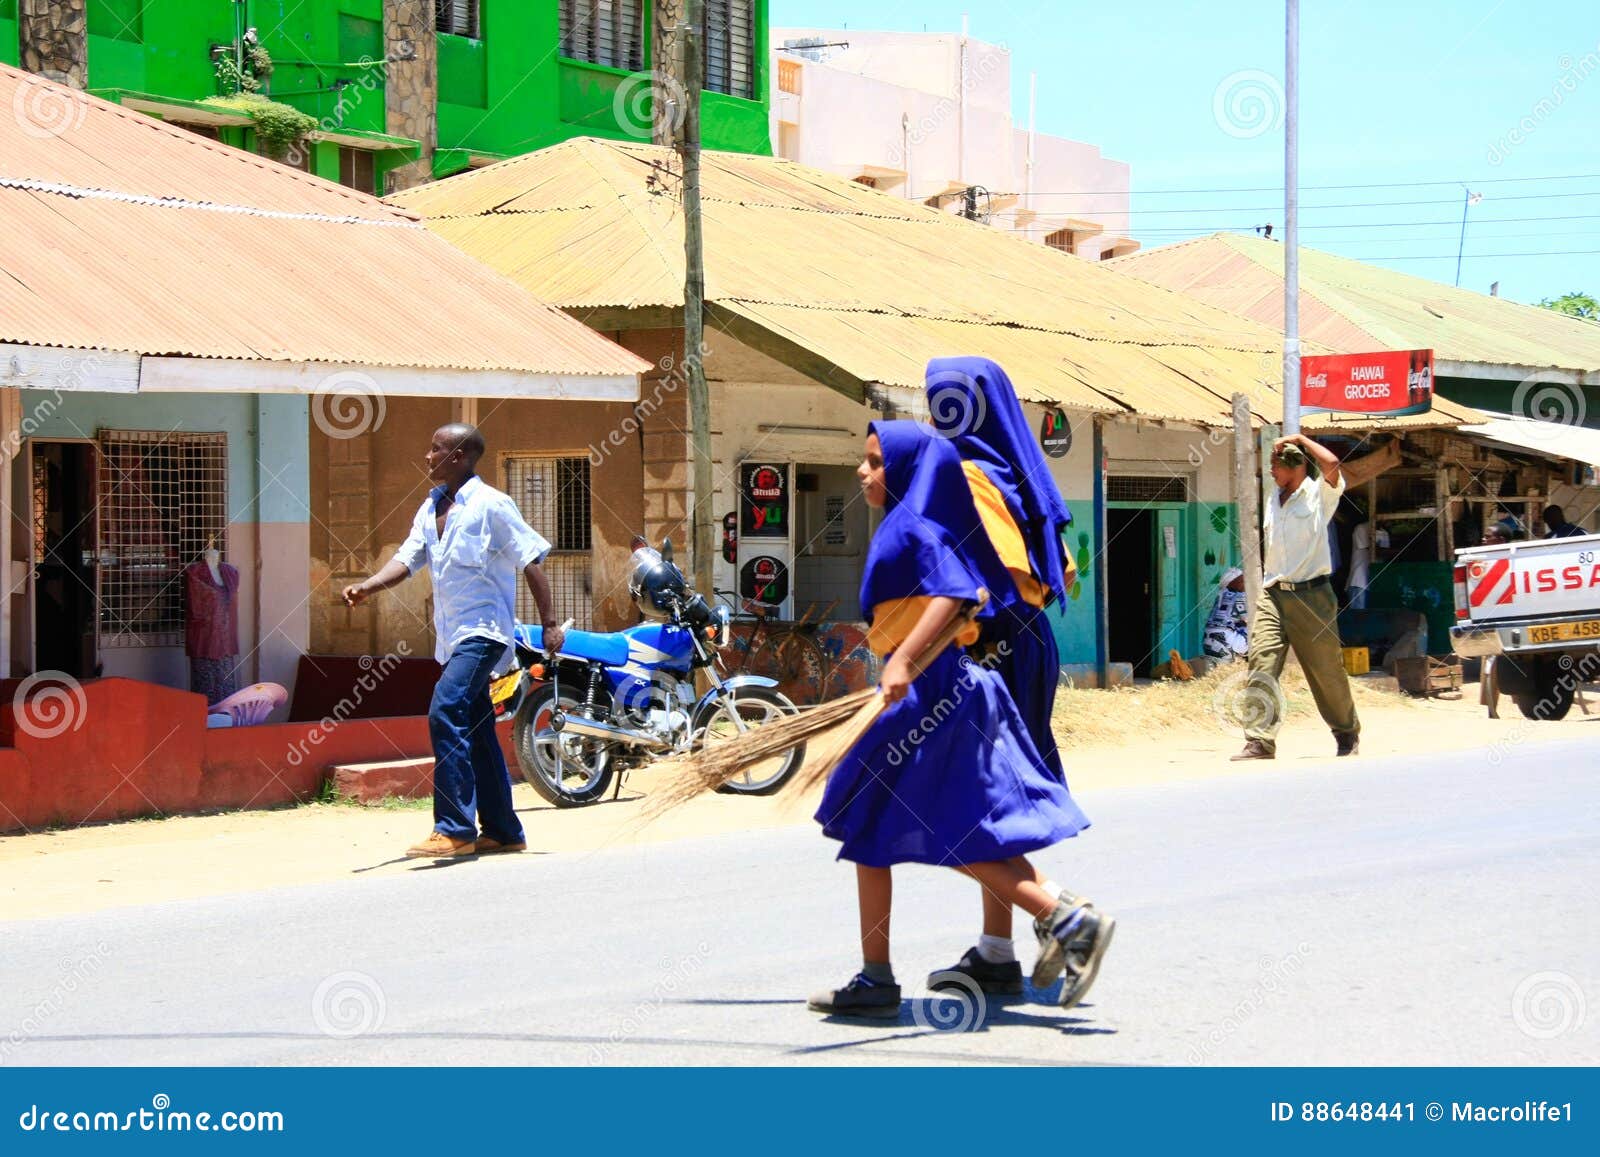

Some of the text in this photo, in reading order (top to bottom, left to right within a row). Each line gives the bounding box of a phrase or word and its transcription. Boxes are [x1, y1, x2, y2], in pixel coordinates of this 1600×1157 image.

[1351, 365, 1385, 381] HAWAI
[1344, 383, 1391, 400] GROCERS
[753, 506, 782, 530] yu
[1578, 551, 1595, 564] 80
[1531, 621, 1600, 643] KBE 458
